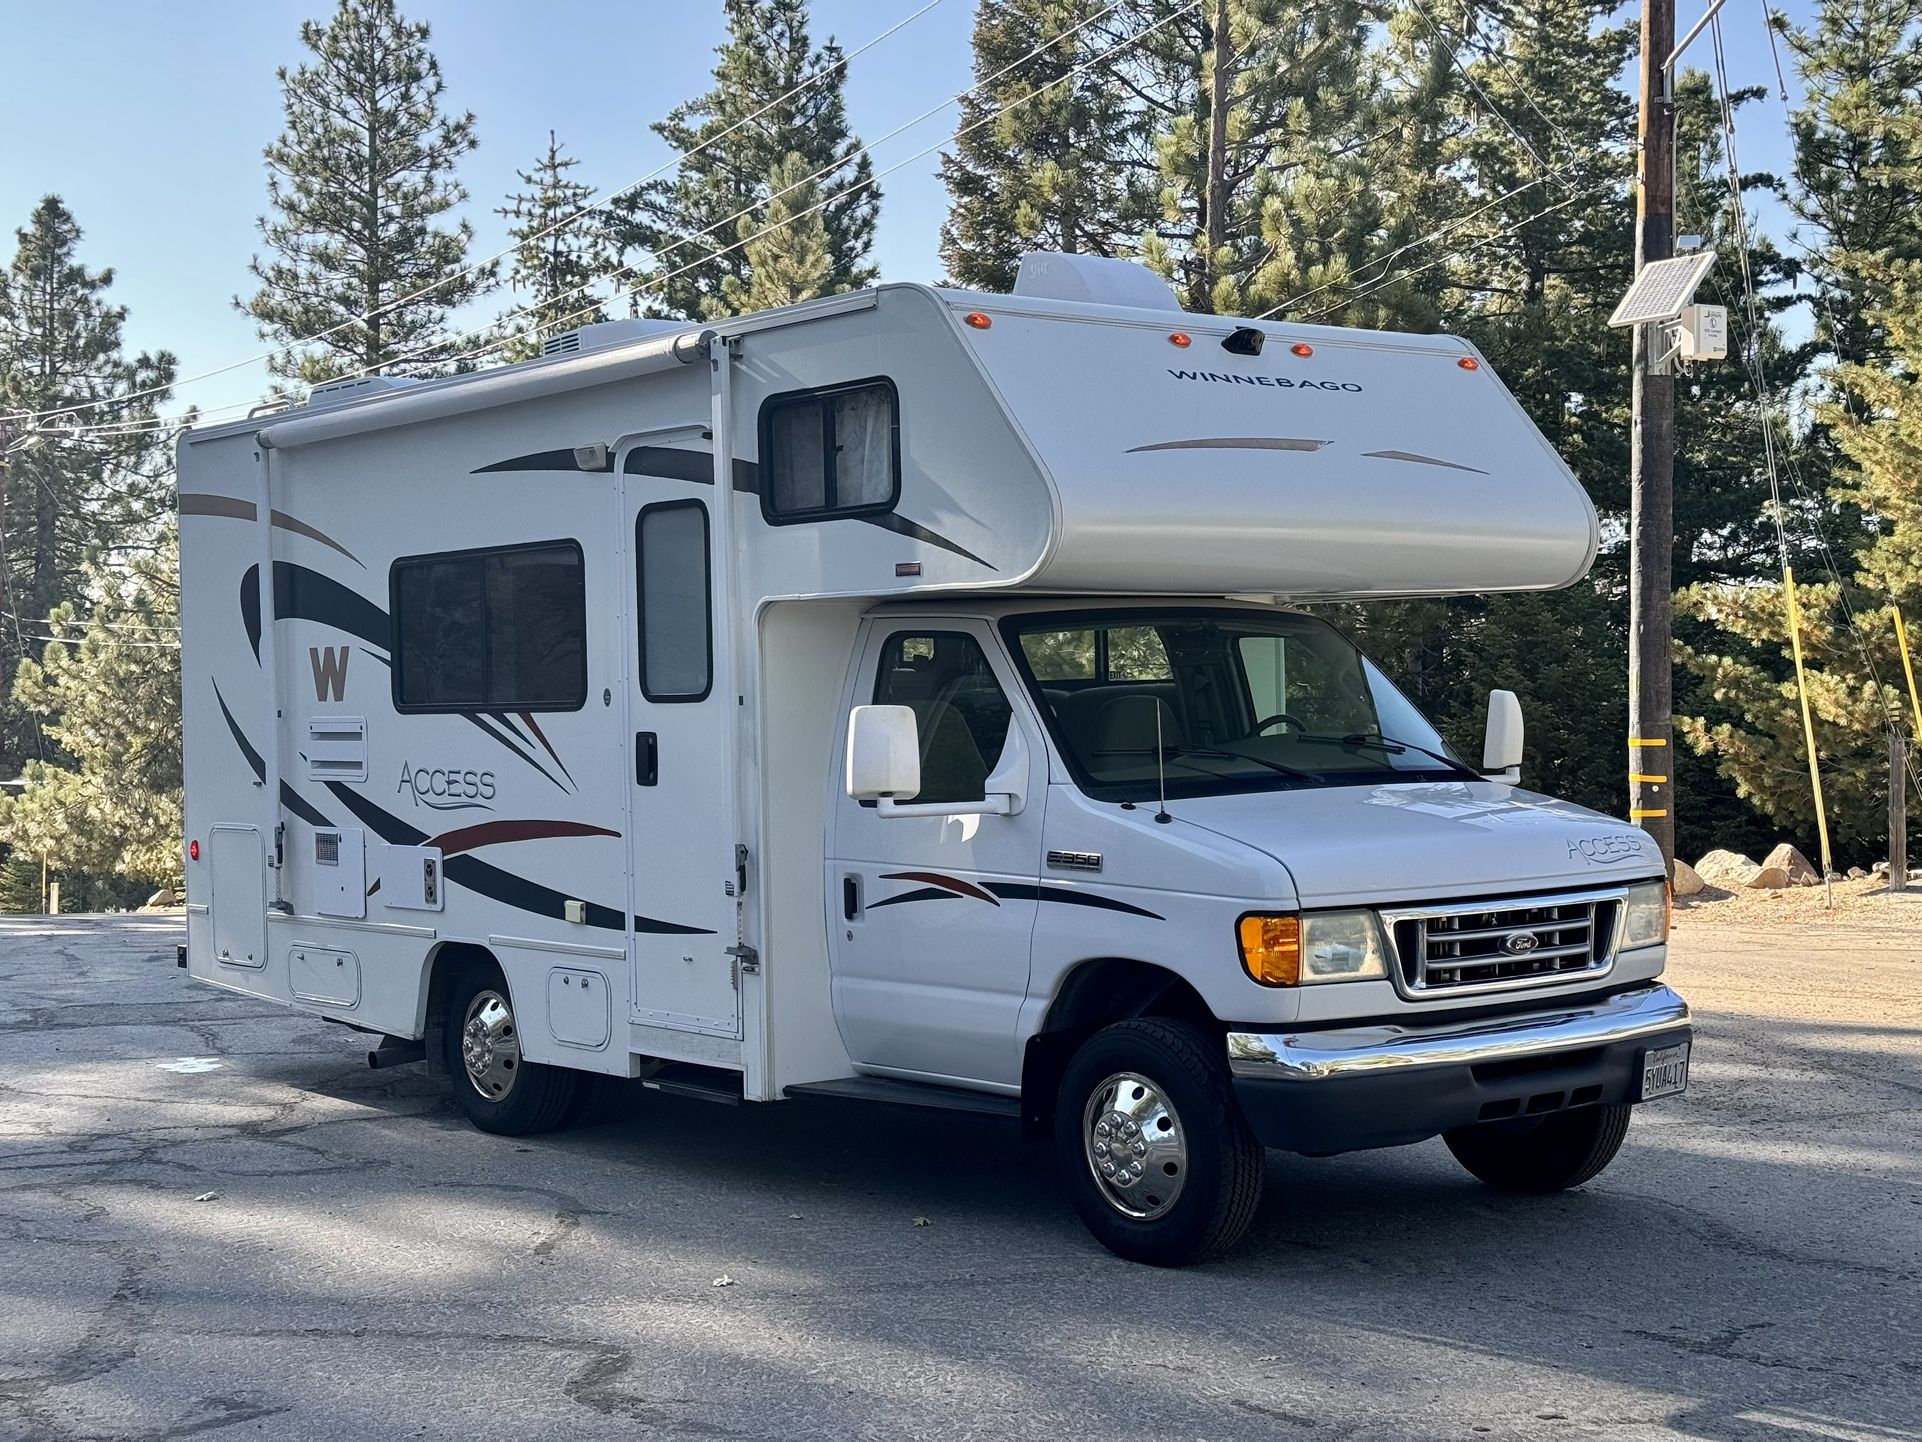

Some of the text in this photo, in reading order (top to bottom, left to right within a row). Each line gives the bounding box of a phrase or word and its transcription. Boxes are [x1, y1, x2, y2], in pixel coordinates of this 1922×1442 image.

[1167, 368, 1363, 393] WINNEBAGO
[309, 646, 350, 702] W
[397, 760, 496, 806] ACCESS
[1566, 835, 1641, 866] ACCESS
[1515, 938, 1532, 950] Ford
[1645, 1060, 1685, 1091] 5YUA417
